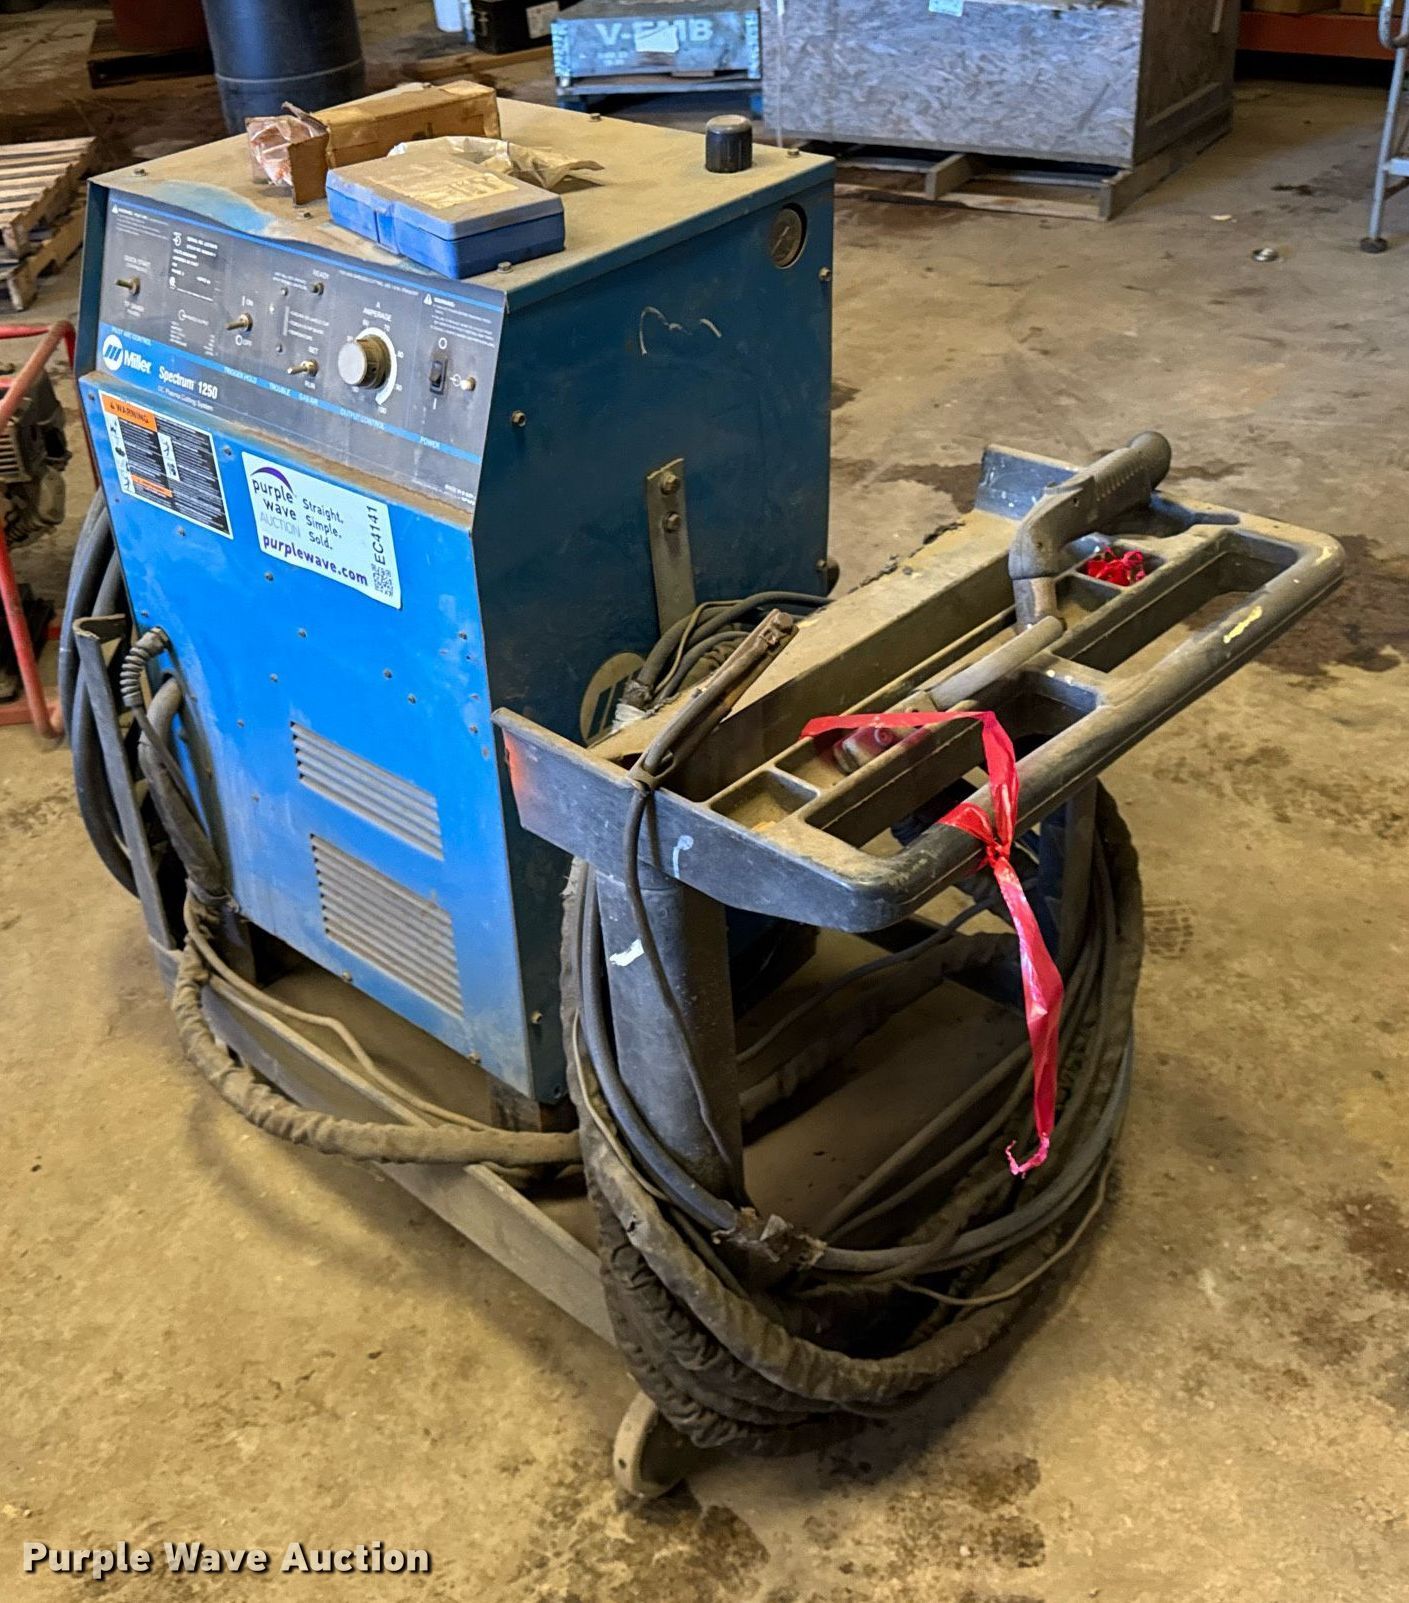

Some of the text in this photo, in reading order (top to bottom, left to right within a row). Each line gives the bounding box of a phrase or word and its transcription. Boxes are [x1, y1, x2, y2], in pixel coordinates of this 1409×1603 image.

[124, 350, 218, 400] Miller Spectrum 1250
[420, 435, 441, 449] POWER
[252, 479, 294, 503] purple
[263, 498, 297, 520] wave
[302, 498, 344, 524] Straight.
[260, 511, 301, 538] AUCTION
[305, 515, 342, 539] Simple.
[366, 505, 386, 566] EC4141
[308, 531, 333, 550] Sold.
[262, 535, 369, 586] purplewave.com
